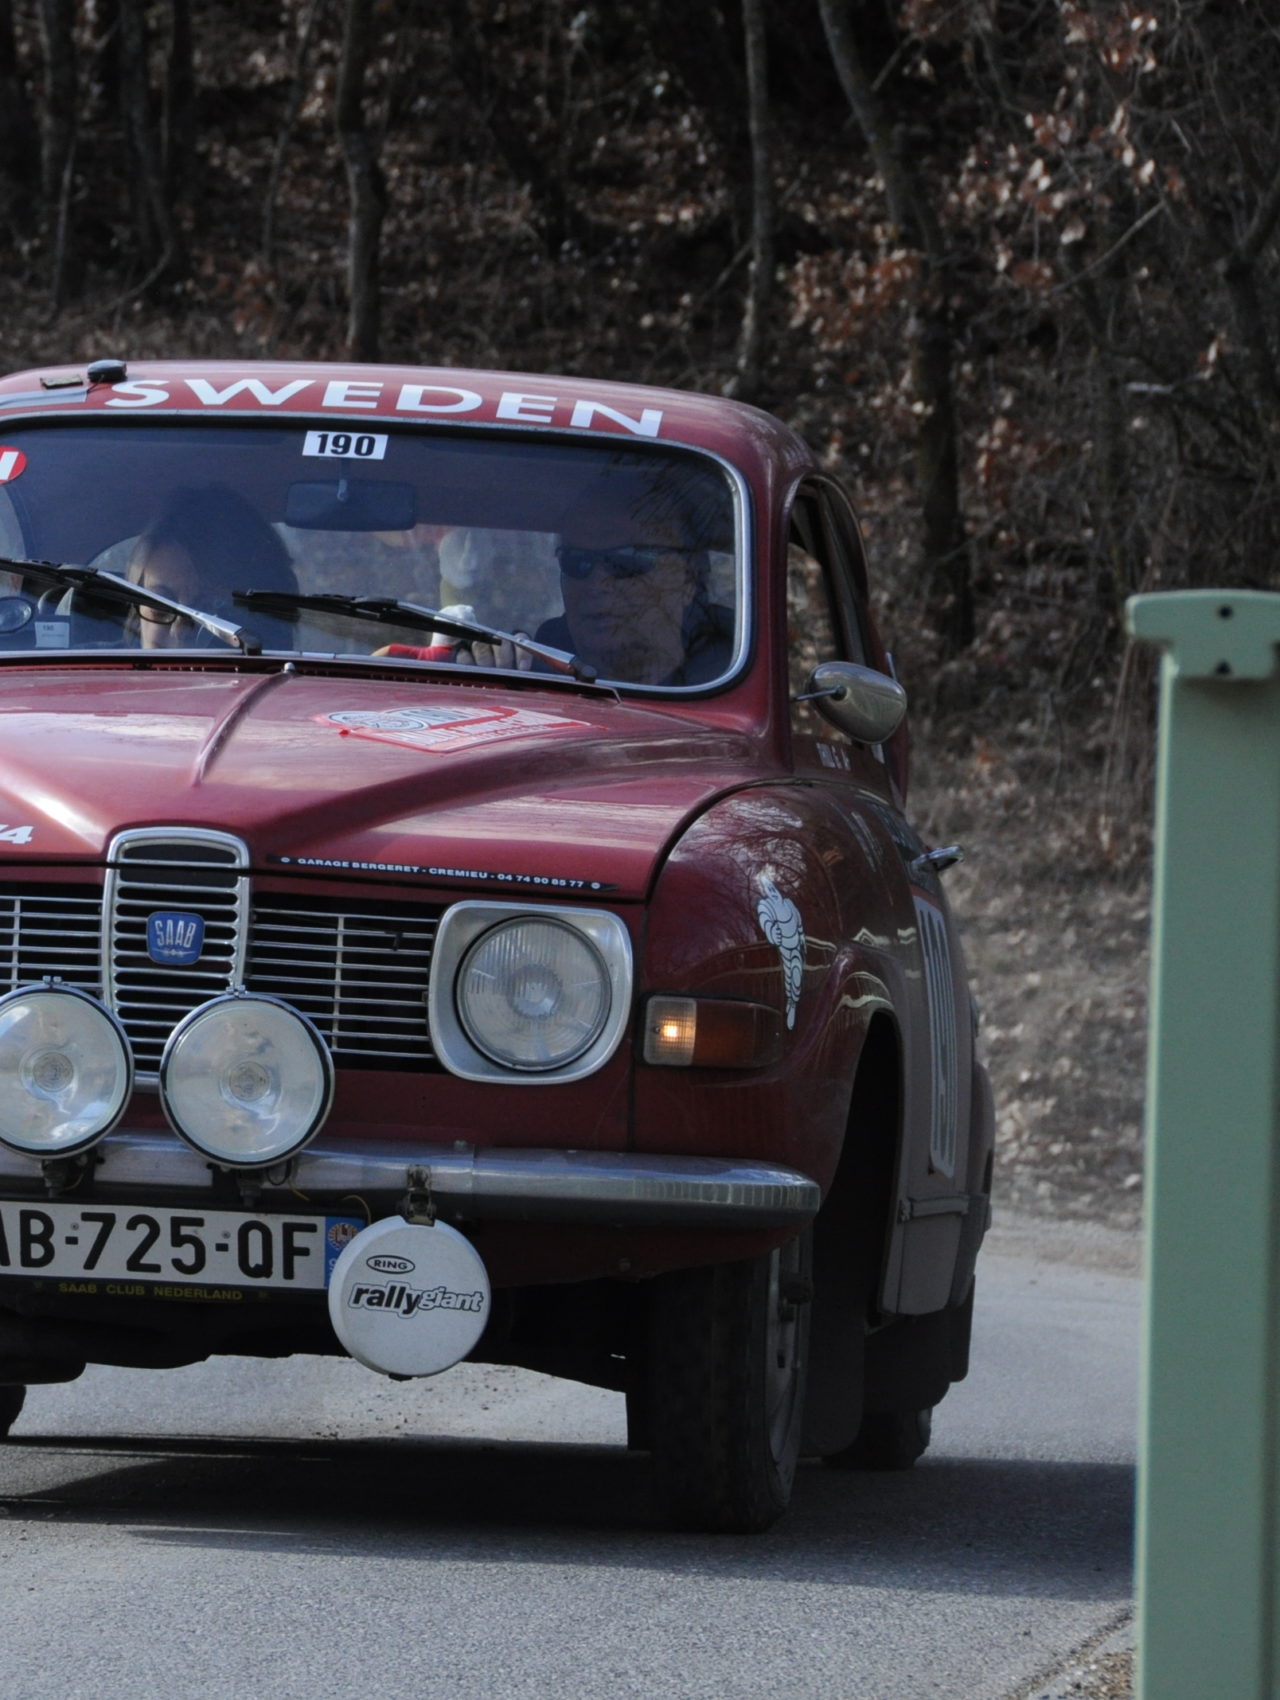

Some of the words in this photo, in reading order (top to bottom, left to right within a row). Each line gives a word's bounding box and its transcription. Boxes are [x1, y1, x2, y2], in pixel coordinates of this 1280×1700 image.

[104, 378, 663, 438] SWEDEN
[317, 433, 376, 456] 190
[297, 857, 350, 868] GARAGE
[351, 861, 420, 874] BERGERET
[428, 867, 488, 879] CREMIEU
[497, 873, 513, 881] 04
[516, 875, 530, 883] 74
[569, 880, 584, 888] 77
[154, 918, 198, 947] SAAB
[373, 1259, 408, 1270] RING
[58, 1282, 97, 1293] SAAB
[106, 1284, 145, 1296] CLUB
[153, 1286, 243, 1300] NEDERLAND
